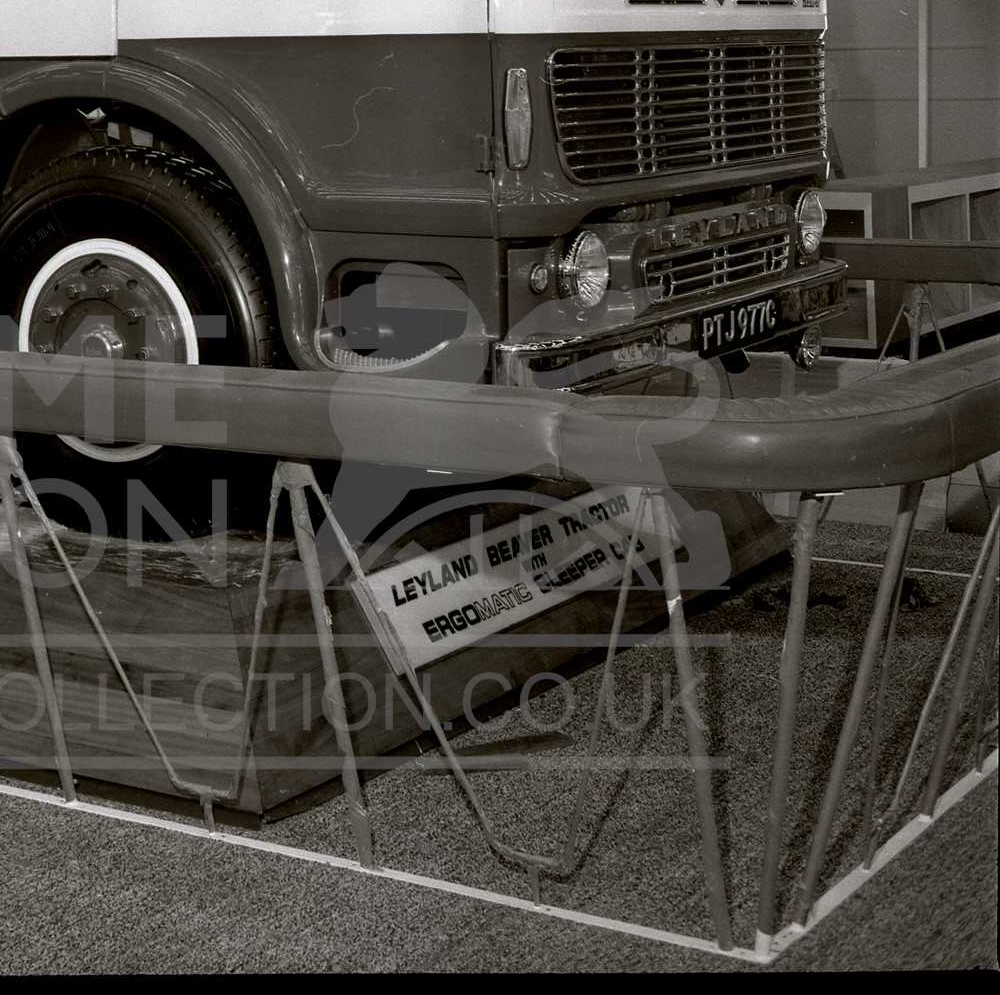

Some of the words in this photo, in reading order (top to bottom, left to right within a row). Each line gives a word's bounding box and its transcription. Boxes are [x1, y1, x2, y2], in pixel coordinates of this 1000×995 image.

[656, 205, 791, 249] LEYLAND
[391, 553, 478, 607] LEYLAND
[485, 523, 553, 567] BEAVER
[558, 493, 630, 536] TRACTOR
[421, 581, 532, 643] ERGOMATIC
[533, 548, 609, 594] SLEEPER
